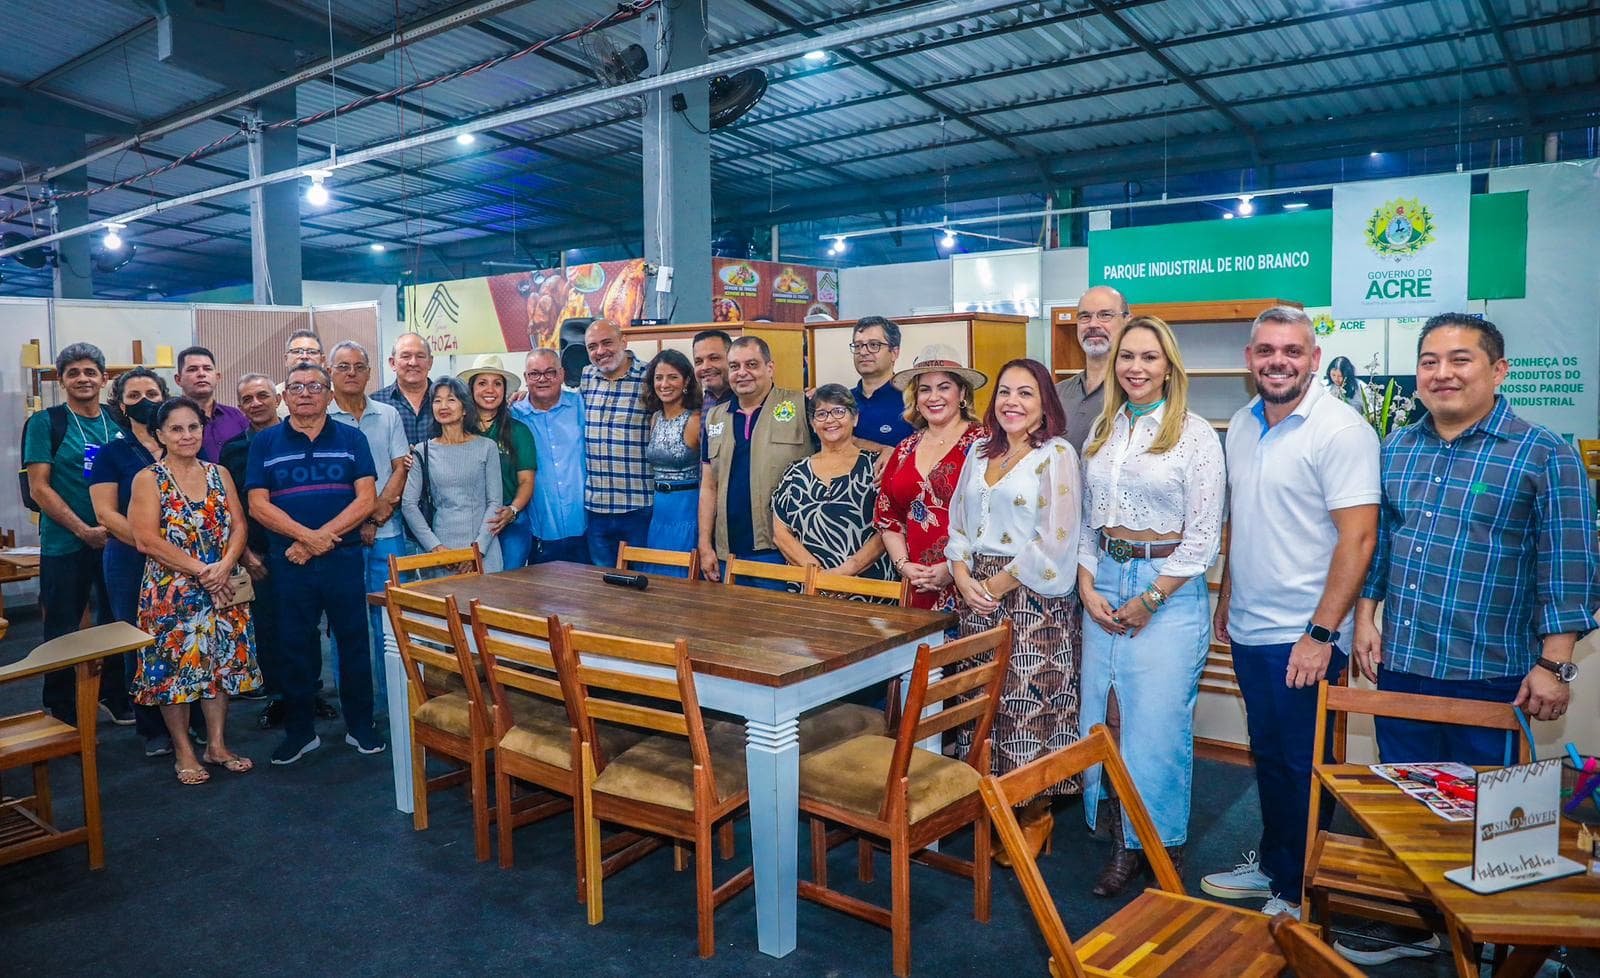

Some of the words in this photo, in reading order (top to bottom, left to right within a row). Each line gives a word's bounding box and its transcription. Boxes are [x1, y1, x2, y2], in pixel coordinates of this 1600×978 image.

[1104, 263, 1146, 280] PARQUE
[1148, 258, 1215, 277] INDUSTRIAL
[1217, 256, 1232, 272] DE
[1235, 255, 1255, 271] RIO
[1258, 251, 1310, 270] BRANCO
[1367, 269, 1415, 280] GOVERNO
[1417, 268, 1432, 278] DO
[1365, 277, 1432, 300] ACRE
[1339, 320, 1366, 331] ACRE
[1507, 357, 1559, 368] CONHEÇA
[1562, 357, 1578, 366] OS
[1504, 370, 1562, 380] PRODUTOS
[1565, 370, 1581, 379] DO
[1499, 384, 1537, 393] NOSSO
[1539, 383, 1584, 393] PARQUE
[1510, 397, 1575, 406] INDUSTRIAL
[275, 463, 344, 483] POLO
